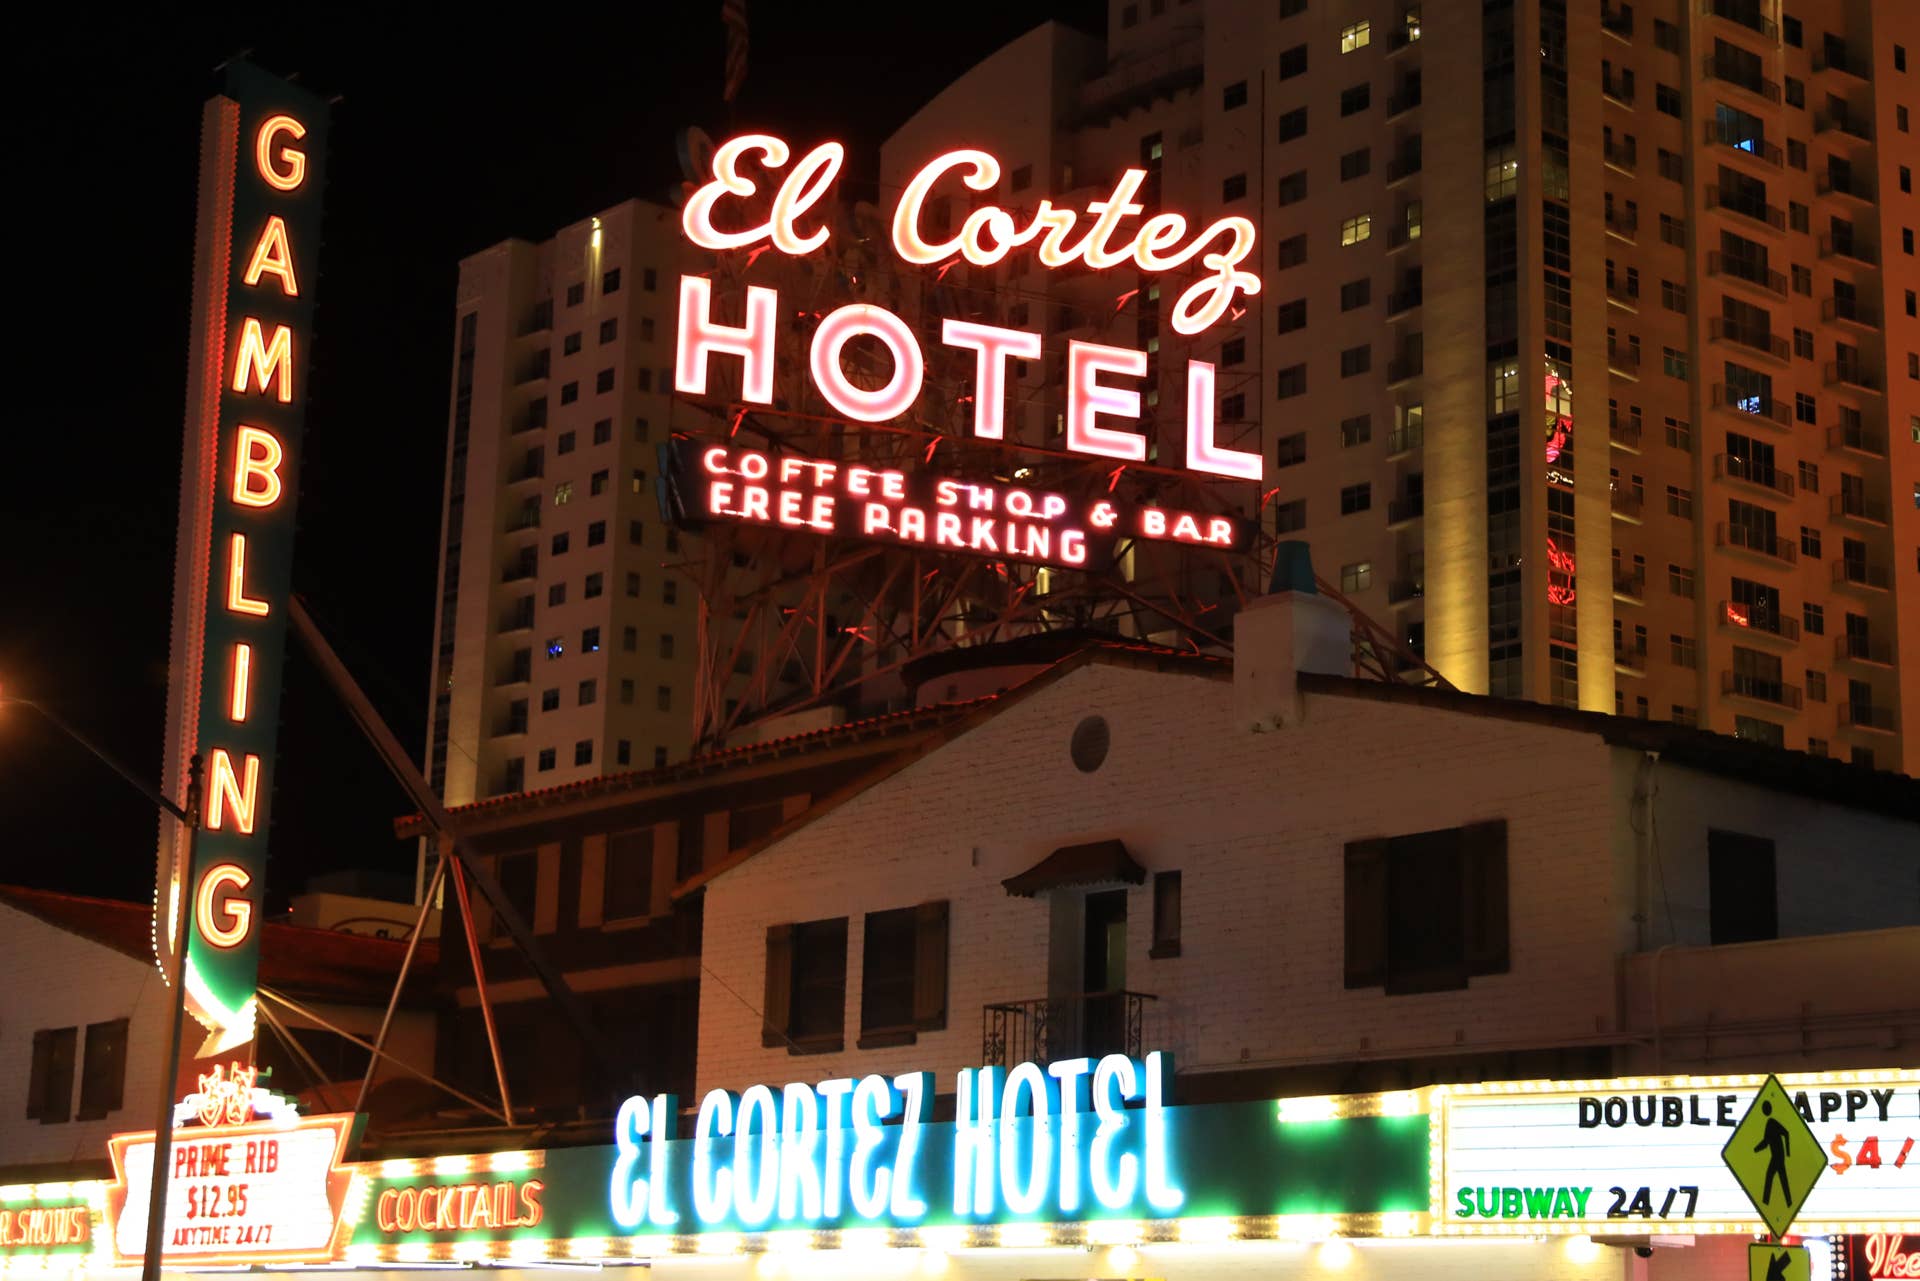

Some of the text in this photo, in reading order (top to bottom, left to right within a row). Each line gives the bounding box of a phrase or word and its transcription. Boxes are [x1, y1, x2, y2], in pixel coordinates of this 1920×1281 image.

[682, 134, 1261, 335] El Cortez
[675, 274, 1263, 481] HOTEL
[703, 448, 1232, 545] COFFEE SHOP & BAR
[197, 115, 306, 948] GAMBLING
[709, 481, 1087, 564] FREE PARKING
[1578, 1094, 1738, 1128] DOUBLE
[1793, 1088, 1895, 1123] APPY
[174, 1140, 279, 1179] PRIME RIB
[611, 1051, 1184, 1228] EL CORTEZ HOTEL
[17, 1206, 87, 1244] SHOWS
[187, 1184, 248, 1220] $12.95
[377, 1181, 545, 1232] COCKTAILS
[1456, 1186, 1699, 1220] SUBWAY 24/7
[172, 1224, 272, 1246] ANYTIME 24/7
